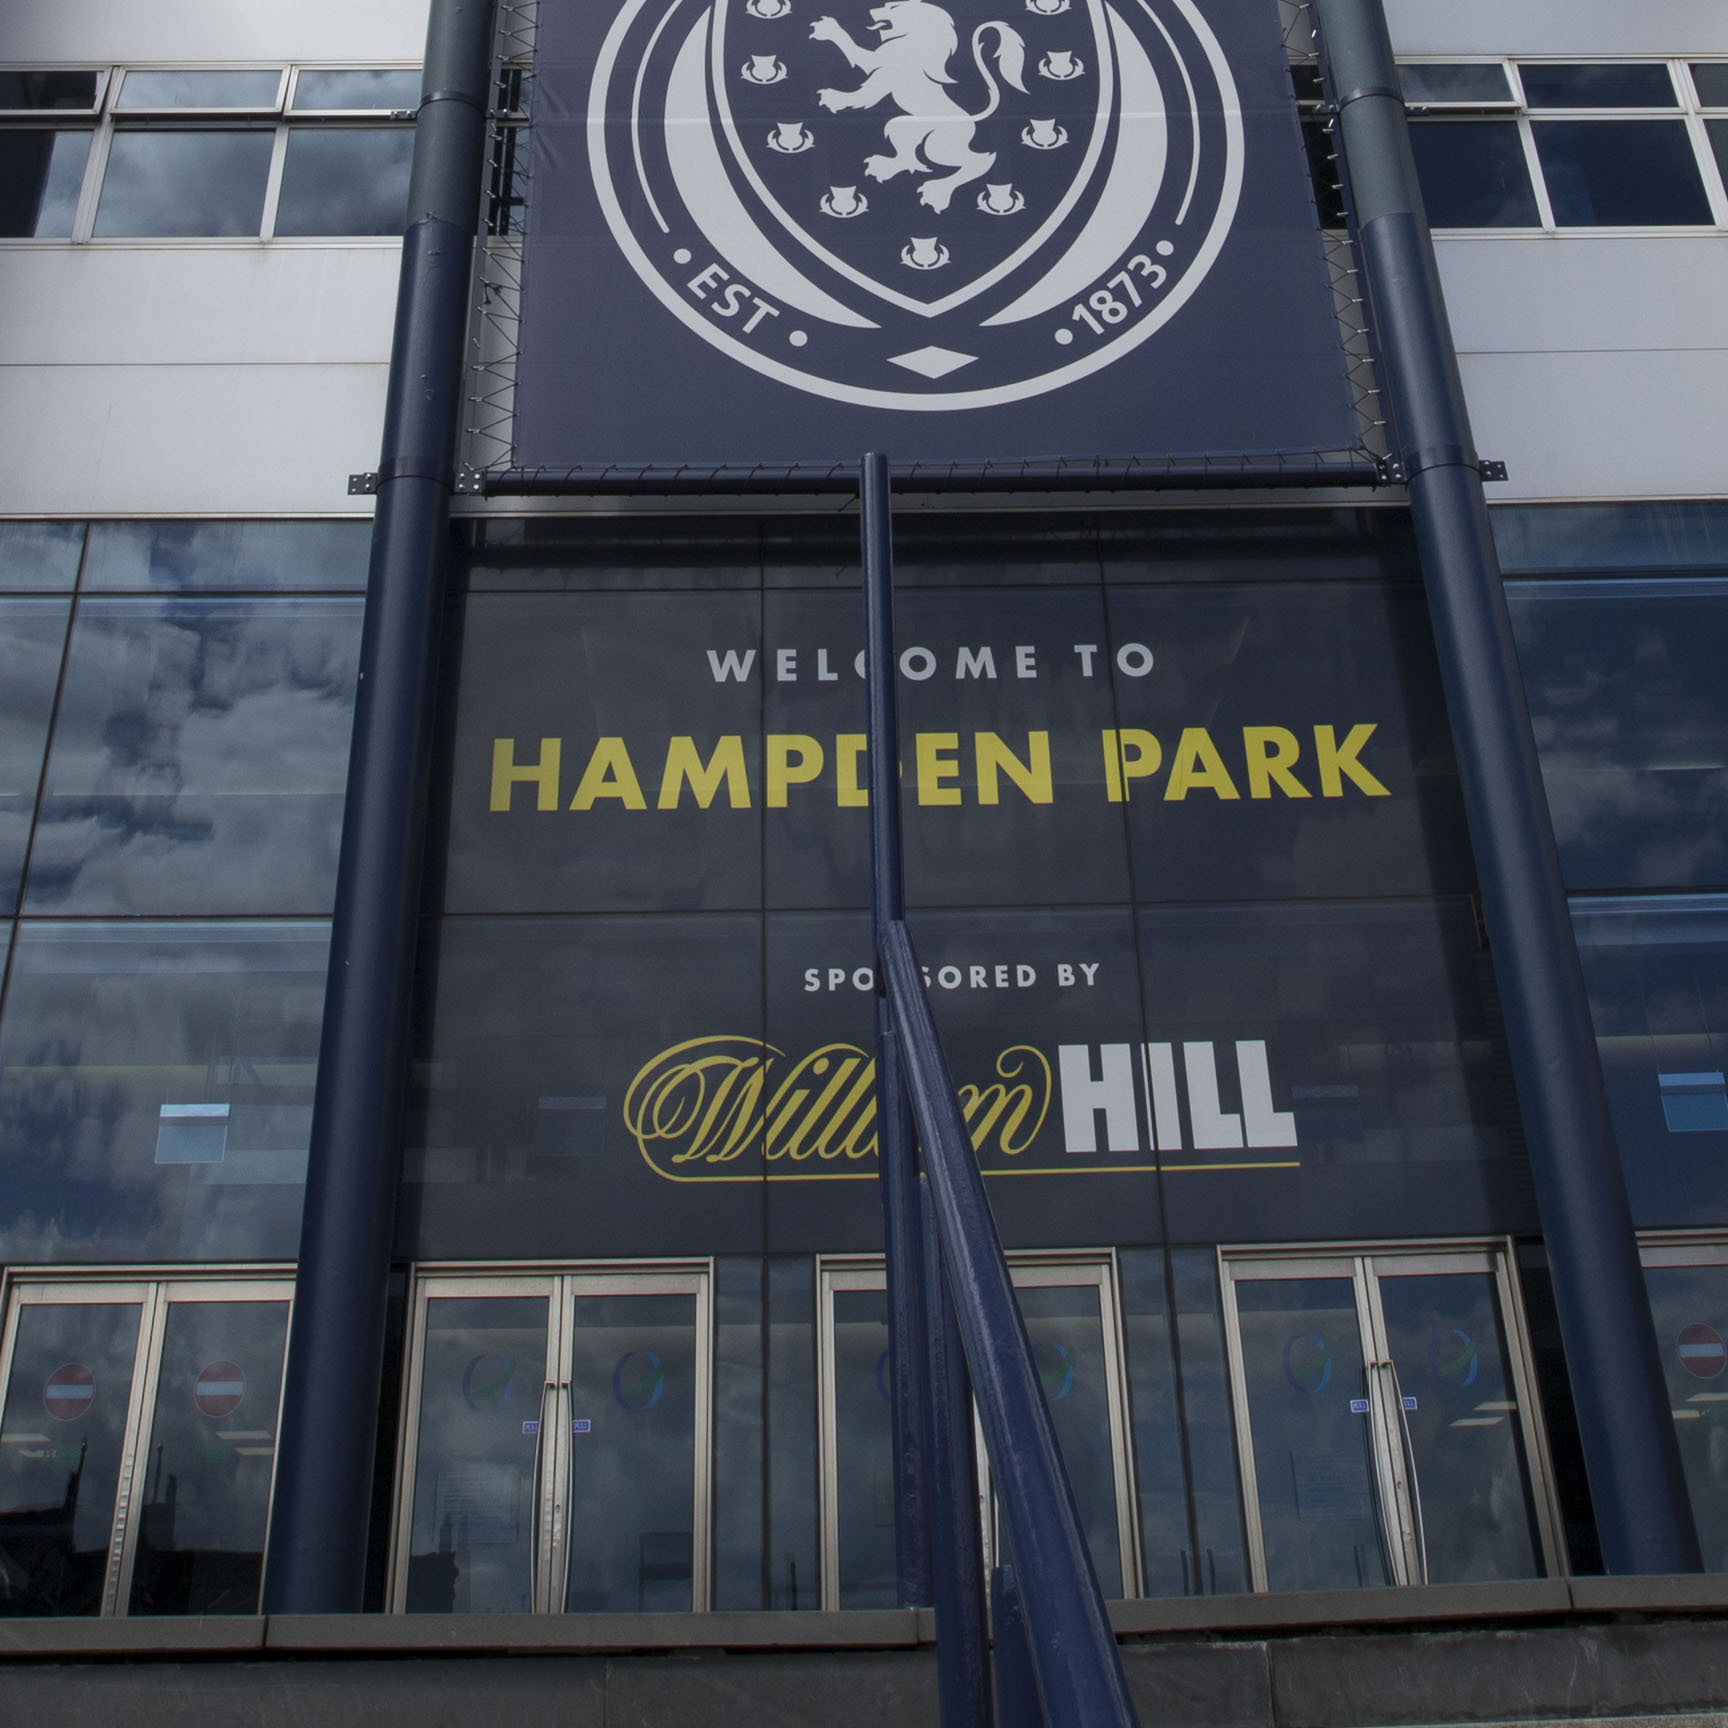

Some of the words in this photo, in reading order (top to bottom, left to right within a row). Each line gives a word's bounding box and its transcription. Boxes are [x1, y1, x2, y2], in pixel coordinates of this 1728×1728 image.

[684, 260, 781, 336] EST
[1071, 252, 1168, 336] 1873
[705, 644, 1039, 684] WELOME
[1073, 641, 1156, 678] TO
[1102, 722, 1393, 804] PARK
[803, 963, 1038, 993] SPOSORED
[1056, 962, 1101, 987] BY
[623, 1035, 1052, 1164] Willm
[1057, 1039, 1299, 1154] HILL
